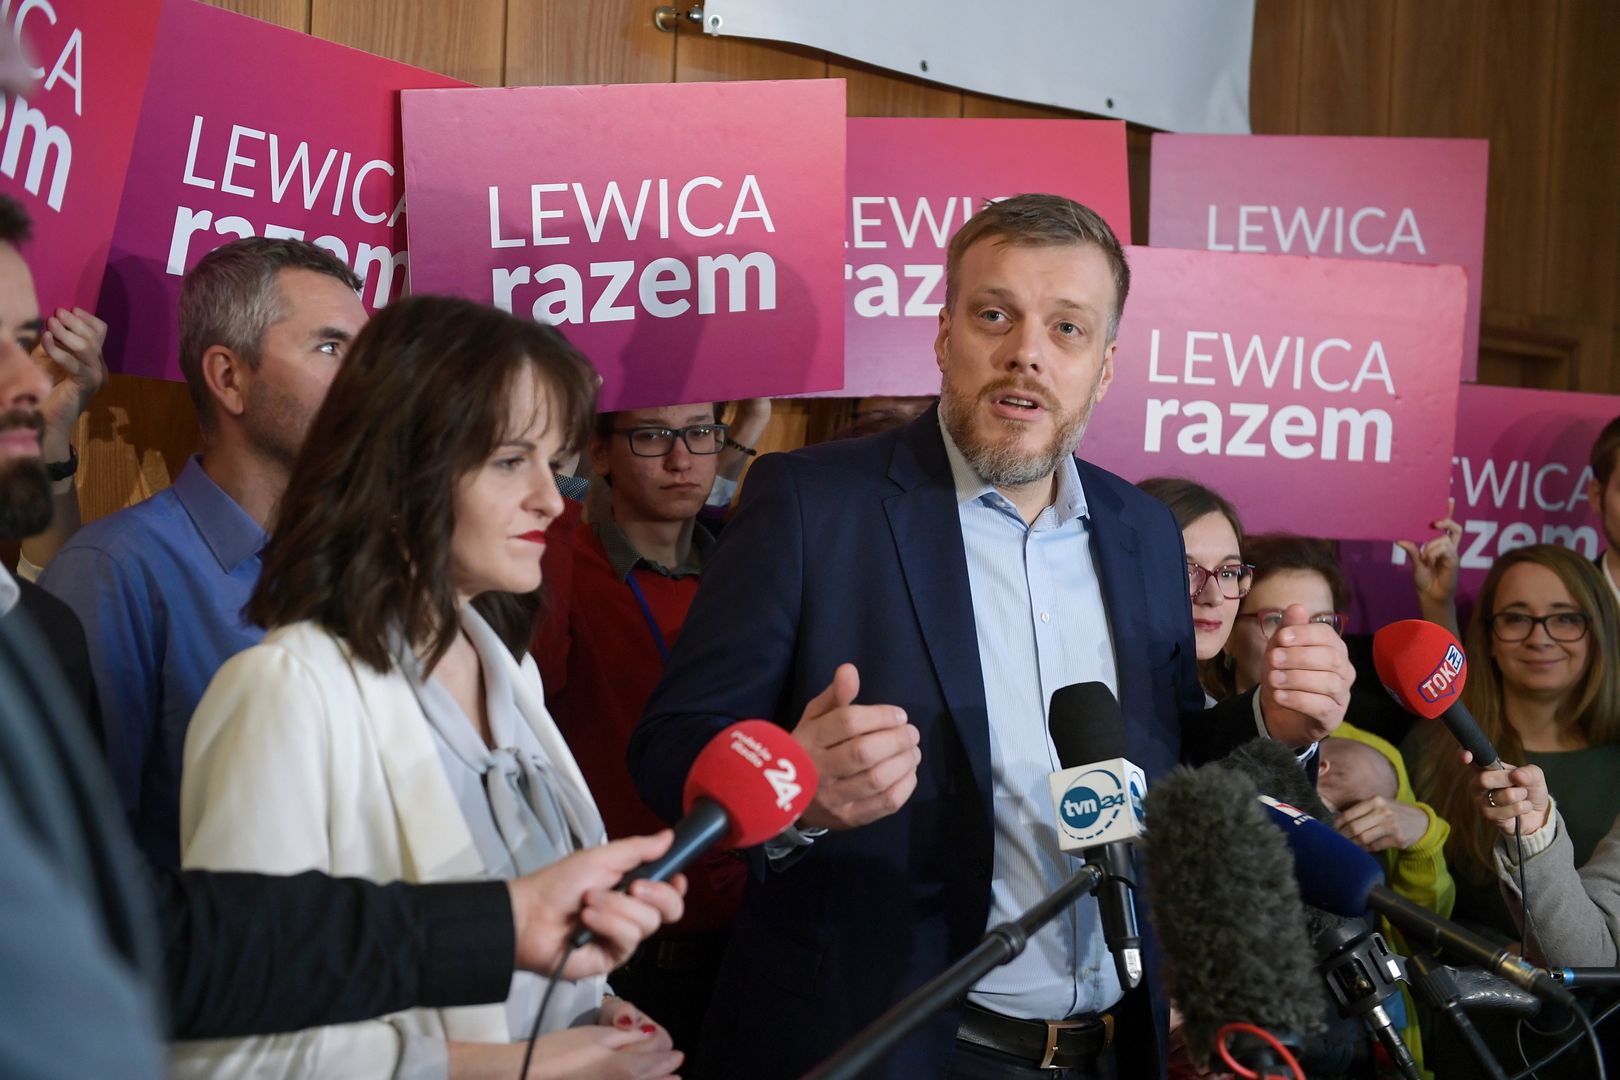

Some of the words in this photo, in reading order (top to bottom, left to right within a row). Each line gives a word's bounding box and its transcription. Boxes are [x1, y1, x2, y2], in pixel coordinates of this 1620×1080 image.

[182, 115, 406, 228] LEWIC
[488, 174, 776, 249] LEWICA
[1207, 204, 1426, 255] LEWICA
[492, 251, 777, 326] razem
[1148, 328, 1397, 395] LEWICA
[1143, 398, 1394, 464] razem
[1422, 661, 1457, 698] TOK
